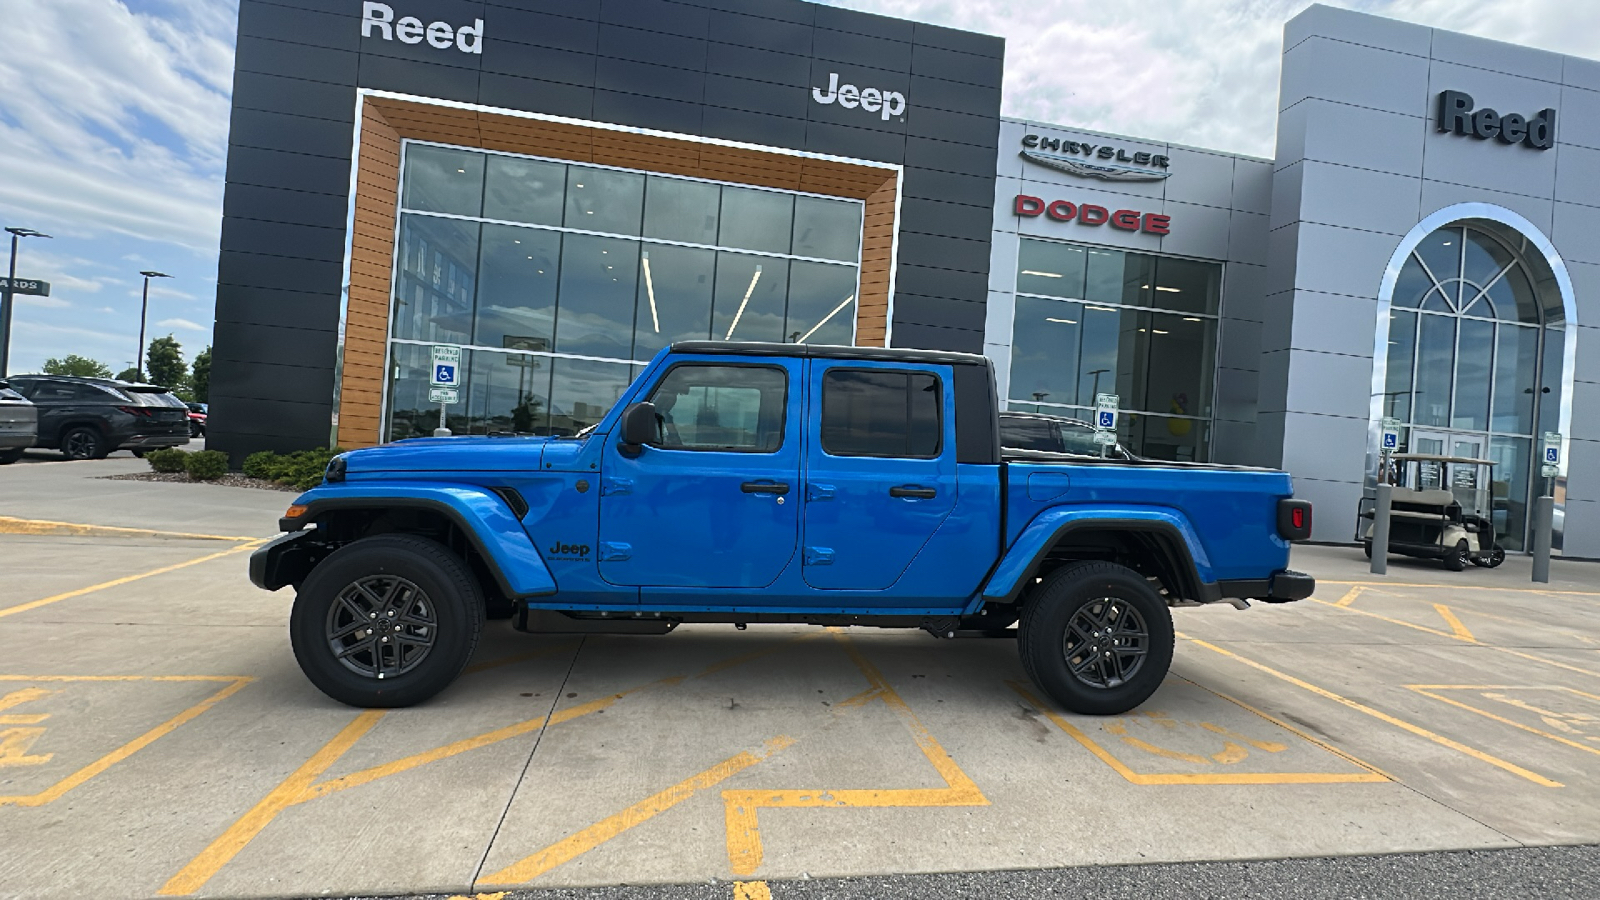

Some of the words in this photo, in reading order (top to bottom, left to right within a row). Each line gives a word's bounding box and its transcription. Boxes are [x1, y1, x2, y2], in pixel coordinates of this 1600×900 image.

[361, 1, 484, 55] Reed
[812, 72, 906, 121] Jeep
[1437, 89, 1556, 150] Reed
[1022, 134, 1170, 168] CHRYSLER
[1014, 194, 1171, 235] DODGE
[549, 540, 590, 557] Jeep
